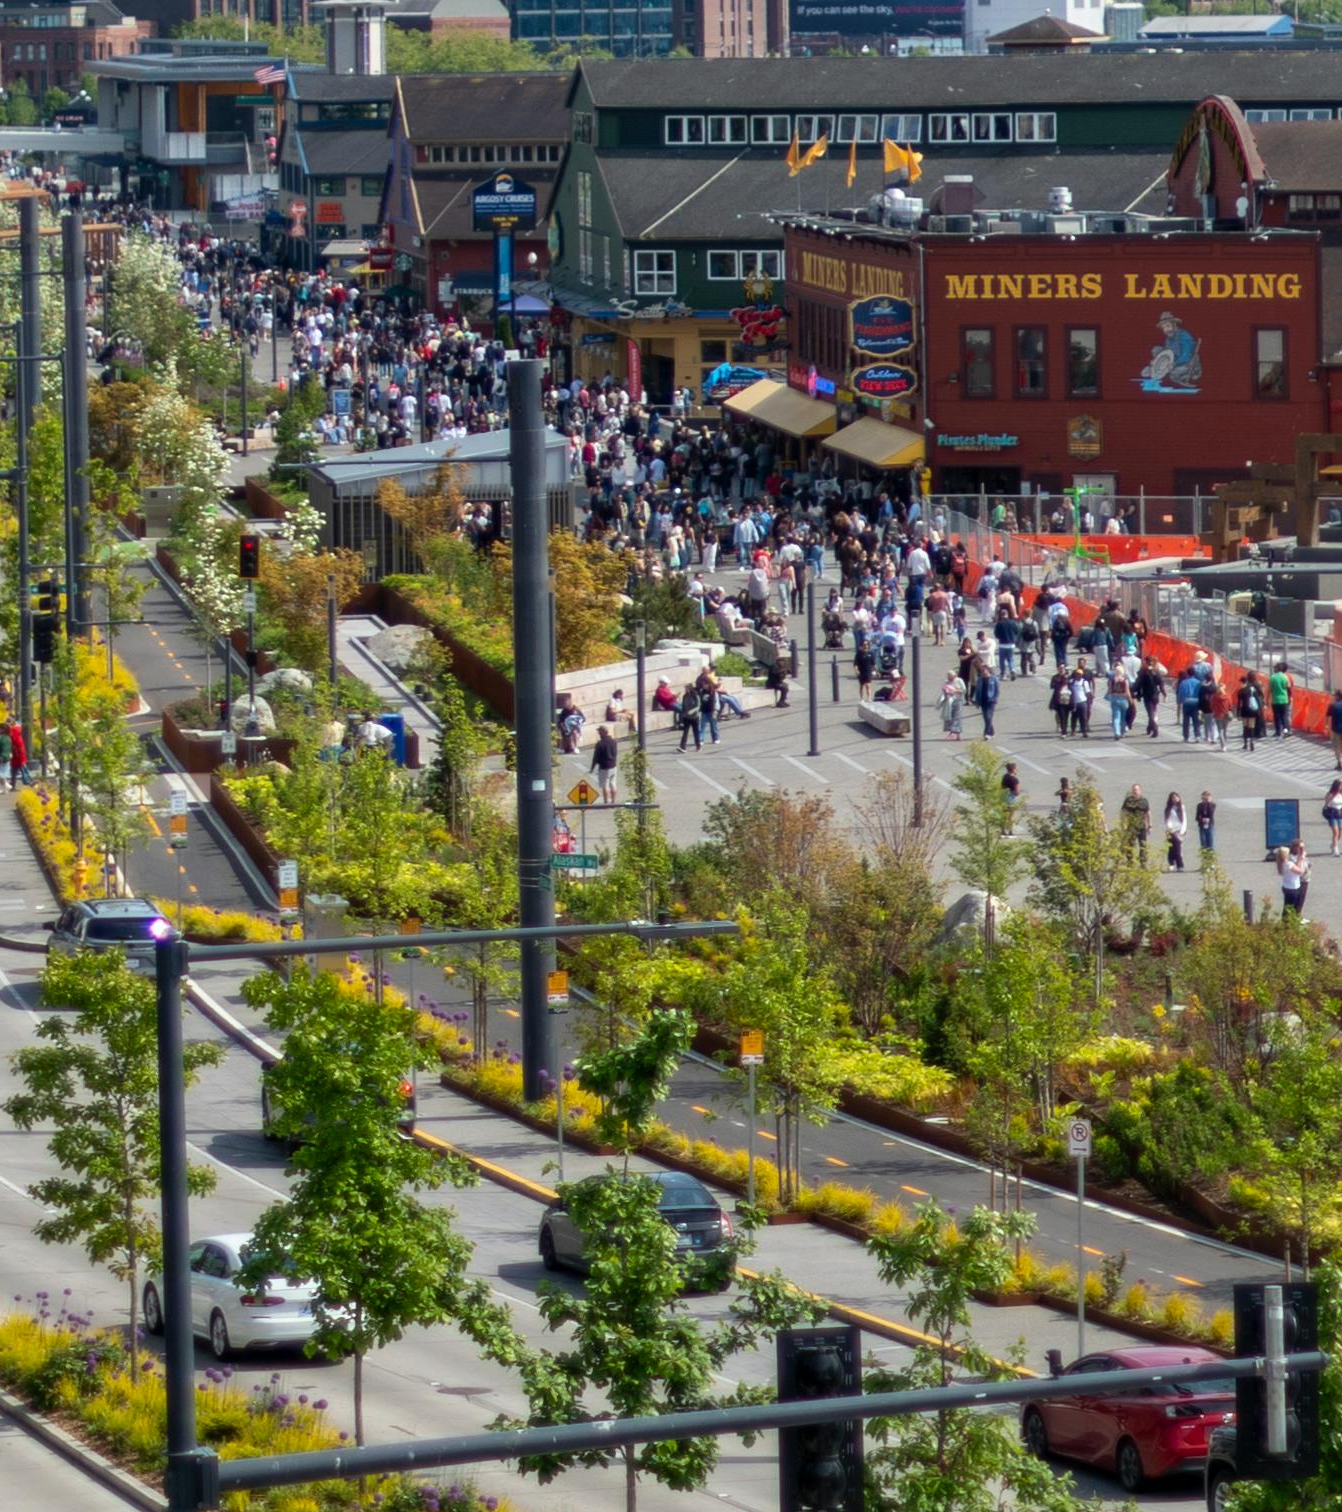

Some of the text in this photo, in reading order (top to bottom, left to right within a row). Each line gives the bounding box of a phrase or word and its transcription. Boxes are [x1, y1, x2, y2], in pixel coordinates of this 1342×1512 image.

[797, 5, 805, 14] If
[806, 7, 823, 17] you
[824, 6, 841, 14] can
[842, 6, 858, 14] see
[859, 5, 875, 14] the
[876, 5, 894, 16] sky,
[475, 194, 535, 203] ARGOSY CRUISES
[803, 251, 904, 297] MINERS LANDING
[454, 287, 494, 295] STARBUCK
[945, 273, 1302, 299] MINERS LANDING
[617, 298, 667, 319] Seattle
[937, 433, 1019, 447] Pirates Plunder
[554, 855, 585, 866] Alaskan
